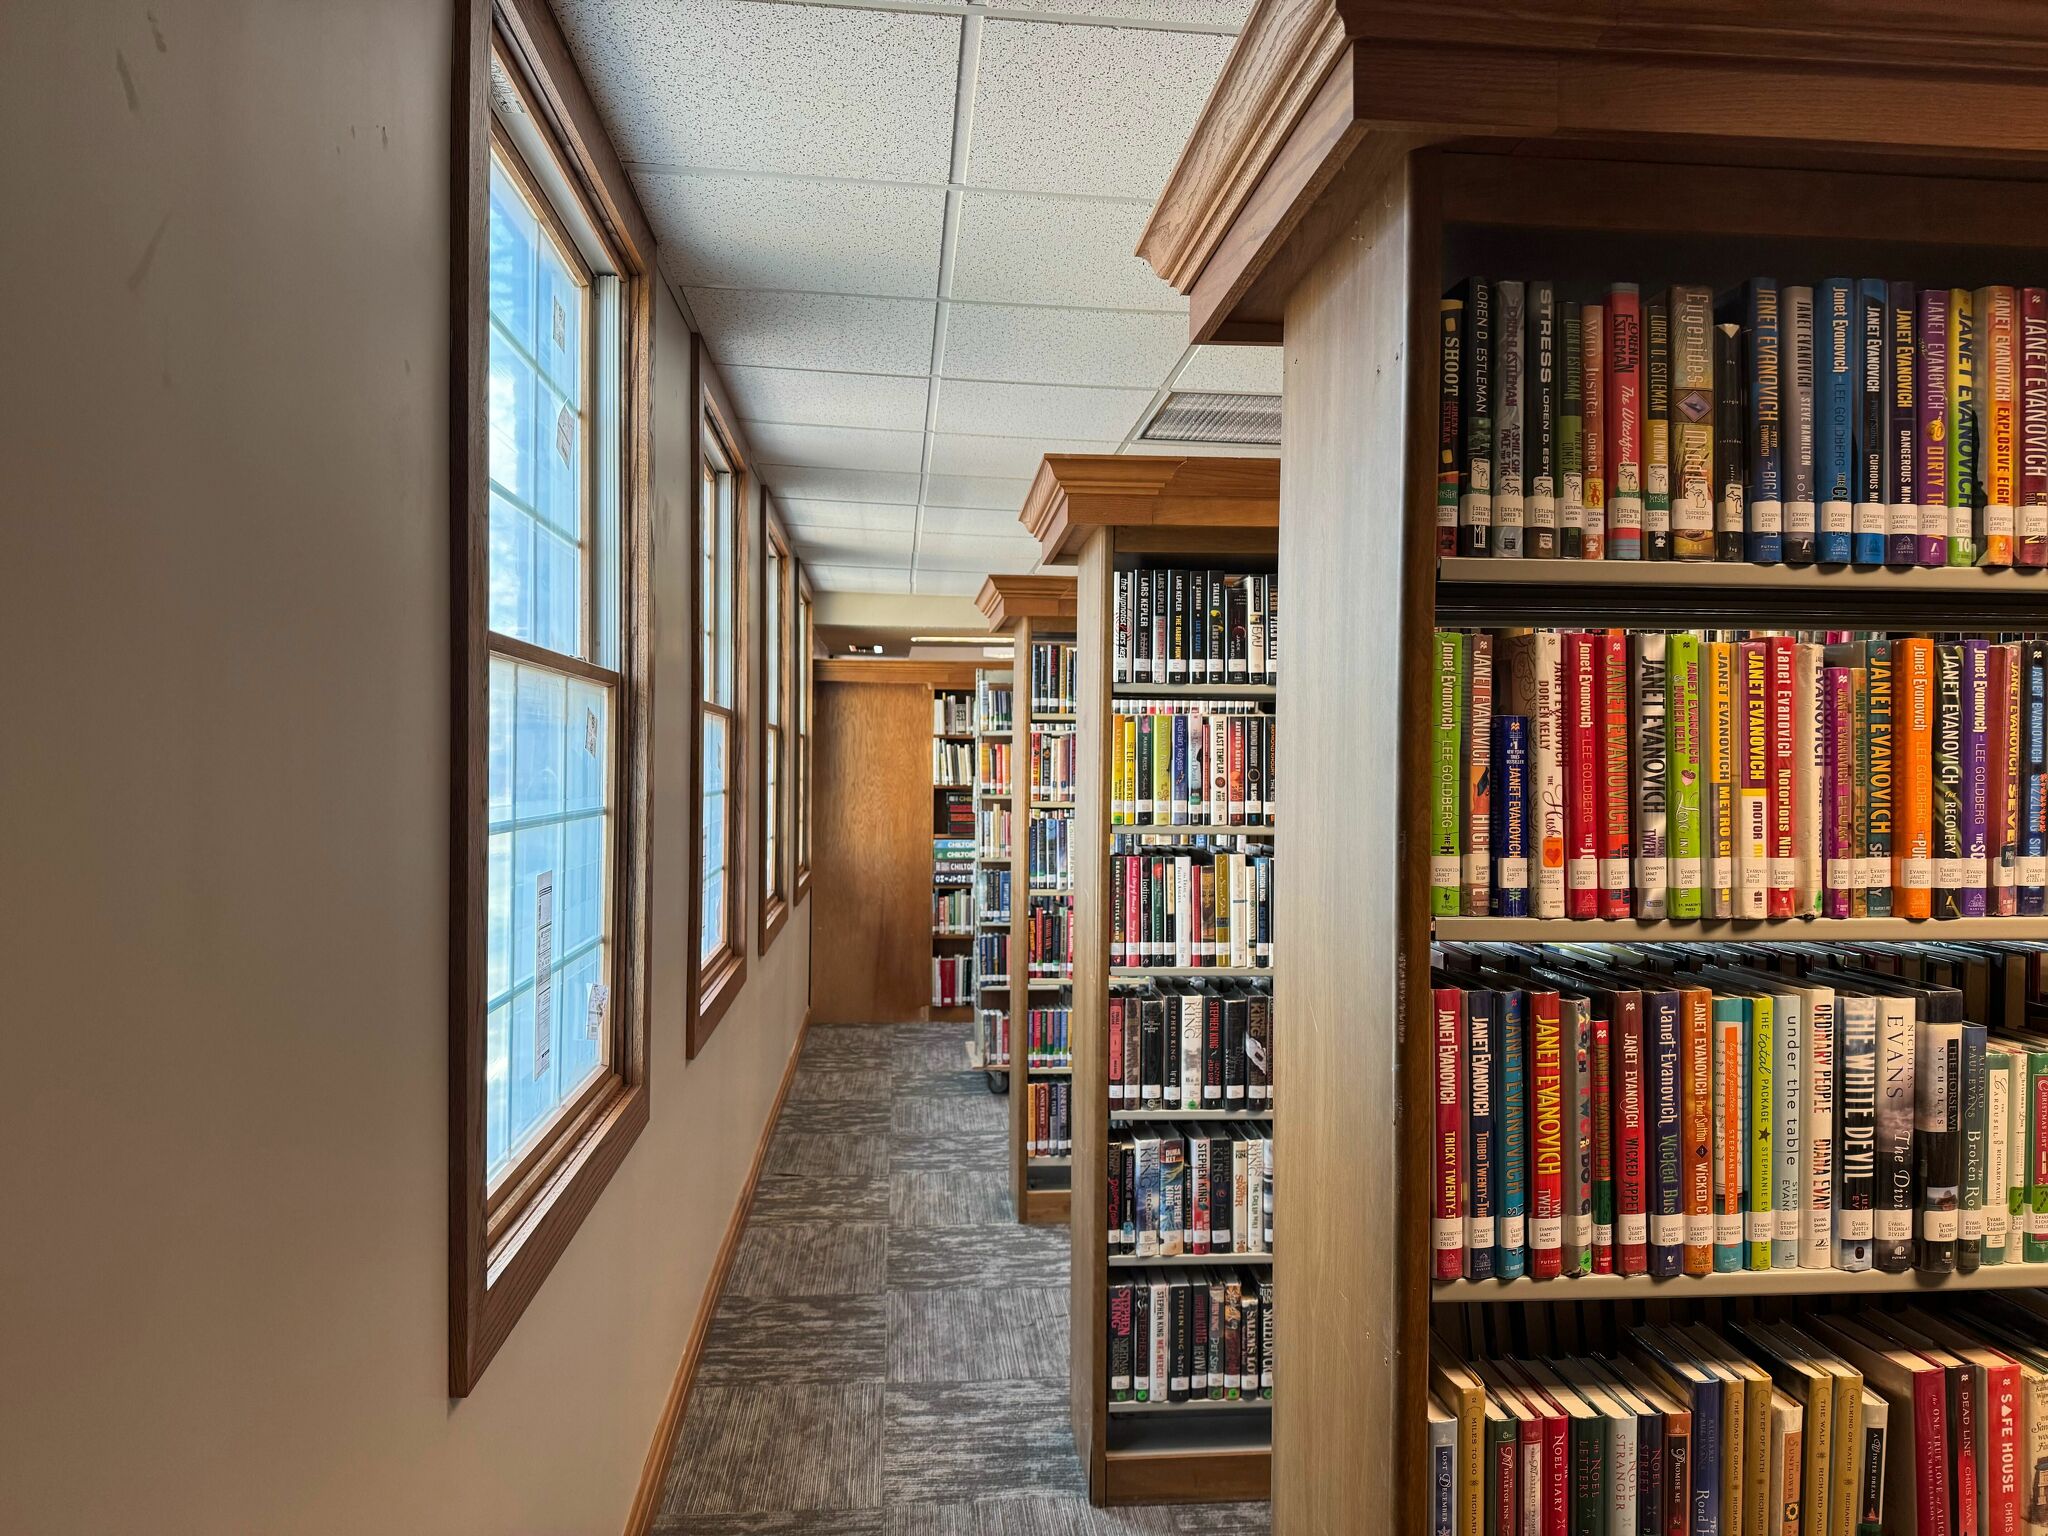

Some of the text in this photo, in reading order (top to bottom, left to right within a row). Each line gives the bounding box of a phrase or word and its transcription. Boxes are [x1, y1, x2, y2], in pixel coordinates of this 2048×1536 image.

[1444, 337, 1459, 396] SHOOT
[1476, 284, 1488, 413] LOREN D. ESTLEMAN
[1540, 289, 1551, 382] STRESS
[1614, 314, 1634, 374] ESTLEMAN
[1652, 314, 1666, 344] LOREN
[1682, 294, 1708, 384] Eugenides
[1756, 288, 1778, 421] JANET EVANOVICH
[1867, 306, 1882, 393] JANET EVANOVICH
[1896, 309, 1913, 408] JANET EVANOVICH
[1928, 298, 1945, 410] JANET EVANOVICH
[1584, 320, 1597, 475] WILD JUSTICE LOREN D.
[1621, 385, 1634, 406] The
[1651, 360, 1667, 412] ESTLEMAN
[1797, 301, 1811, 466] JANET EVANOVICH STEVE HAMILTON
[1832, 287, 1848, 467] Janet Evanovich LEE GOLDBERG
[1957, 309, 1973, 507] JANET EVANOVICH
[1995, 294, 2011, 472] JANET EVANOVICH EXPLOSIVE
[2025, 317, 2048, 477] JANET EVANOVICH
[1543, 433, 1549, 445] D.
[1652, 424, 1664, 462] YOU KNOW
[1869, 454, 1879, 489] CURIOUS
[1900, 430, 1911, 481] DANGEROUS
[1927, 446, 1945, 487] DIRTY
[1140, 578, 1149, 627] LARS KEPLER
[1538, 680, 1550, 750] DORIEN KELLY
[1748, 651, 1765, 780] JANET EVANOVICH
[1777, 648, 1792, 758] Janet Evanovich
[1942, 653, 1958, 784] JANET EVANOVICH
[1973, 648, 1987, 732] Janet Evanovich
[1216, 752, 1224, 774] TEMPLAR
[1440, 642, 1455, 828] Janet Evanovich LEE GOLDBERG
[1579, 642, 1593, 823] Janet Evanovich LEE GOLDBERG
[1606, 654, 1628, 836] JANET EVANOVICH
[1642, 656, 1665, 814] JANET EVANOVICH
[1870, 658, 1891, 834] JANET EVANOVICH
[1509, 766, 1522, 858] JANET EVANOVICH
[1718, 786, 1730, 837] METRO
[1752, 802, 1762, 840] MOTOR
[1778, 769, 1791, 830] Notorious
[1944, 802, 1956, 854] RECOVERY
[947, 851, 976, 859] CHILTO
[1209, 1001, 1219, 1048] STEPHEN KING
[1439, 1010, 1458, 1105] JANET EVANOVICH
[1814, 1004, 1832, 1114] ORDINARY PEOPLE
[1886, 1016, 1904, 1098] EVANS
[1472, 1017, 1492, 1117] JANET EVANOVICH
[1536, 1015, 1560, 1176] JANET EVANOVICH
[1620, 1034, 1638, 1128] JANET EVANOVICH
[1658, 1006, 1678, 1128] Janet Evanovich
[1756, 1030, 1772, 1124] total PACKAGE
[1786, 1016, 1800, 1166] under the table
[1844, 1002, 1875, 1183] THE WHITE DEVIL
[1198, 1143, 1207, 1203] STEPHEN KING
[1444, 1131, 1456, 1164] TRICKY
[1696, 1162, 1707, 1202] WICKED
[1894, 1130, 1910, 1162] The
[1967, 1131, 1980, 1186] Broken
[1111, 1288, 1130, 1336] STEPHEN KING
[1472, 1446, 1477, 1458] TO
[1472, 1462, 1477, 1475] GO
[1554, 1432, 1564, 1512] NOEL DIARY
[1580, 1440, 1588, 1498] LETTERS
[1616, 1434, 1626, 1510] STRANGER
[1670, 1448, 1685, 1503] PROMISE ME
[1964, 1466, 1972, 1496] CHRIS
[2002, 1442, 2014, 1493] HOUSE
[1438, 1474, 1451, 1523] DECEMBER
[1696, 1490, 1710, 1522] Road
[2004, 1503, 2012, 1533] CHRIS
